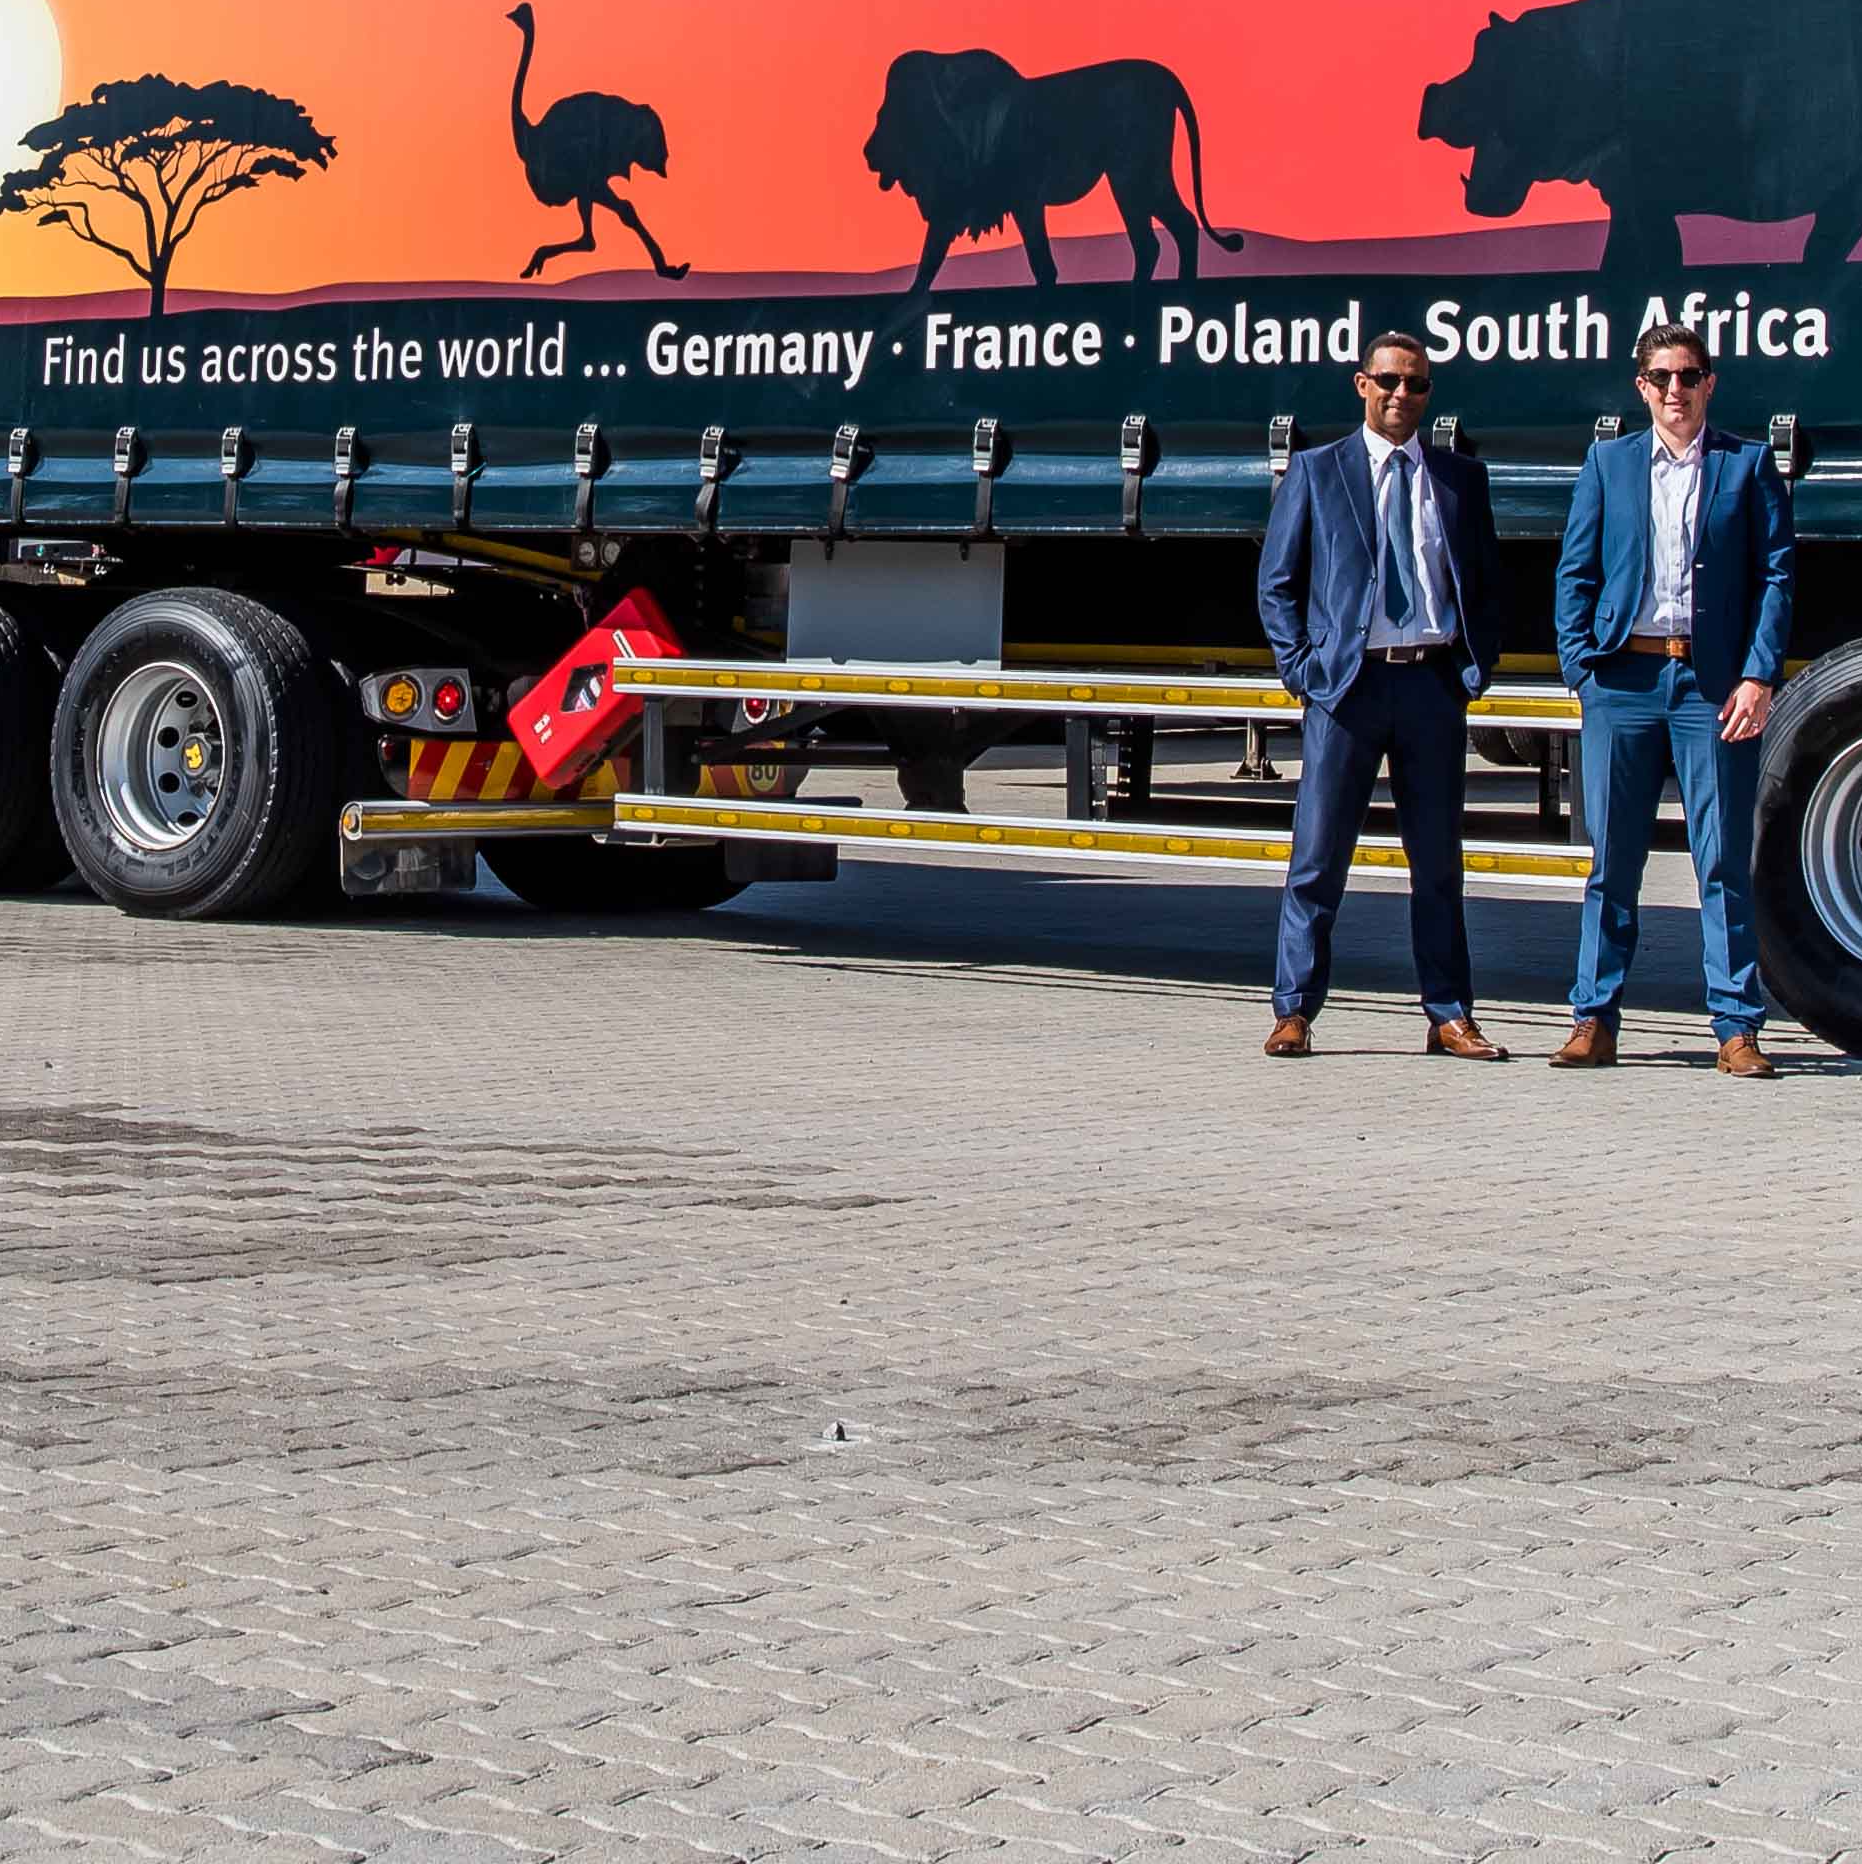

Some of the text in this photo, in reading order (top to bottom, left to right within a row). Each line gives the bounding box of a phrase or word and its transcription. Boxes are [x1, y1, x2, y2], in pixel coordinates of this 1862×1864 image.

[45, 334, 124, 384] Find
[143, 346, 185, 383] us
[202, 343, 335, 382] across
[354, 328, 421, 381] the
[440, 322, 564, 377] world
[647, 323, 872, 389] Germany
[927, 314, 1101, 369] France
[1161, 301, 1359, 363] Poland
[1426, 295, 1607, 362] South
[1632, 291, 1829, 358] Africa
